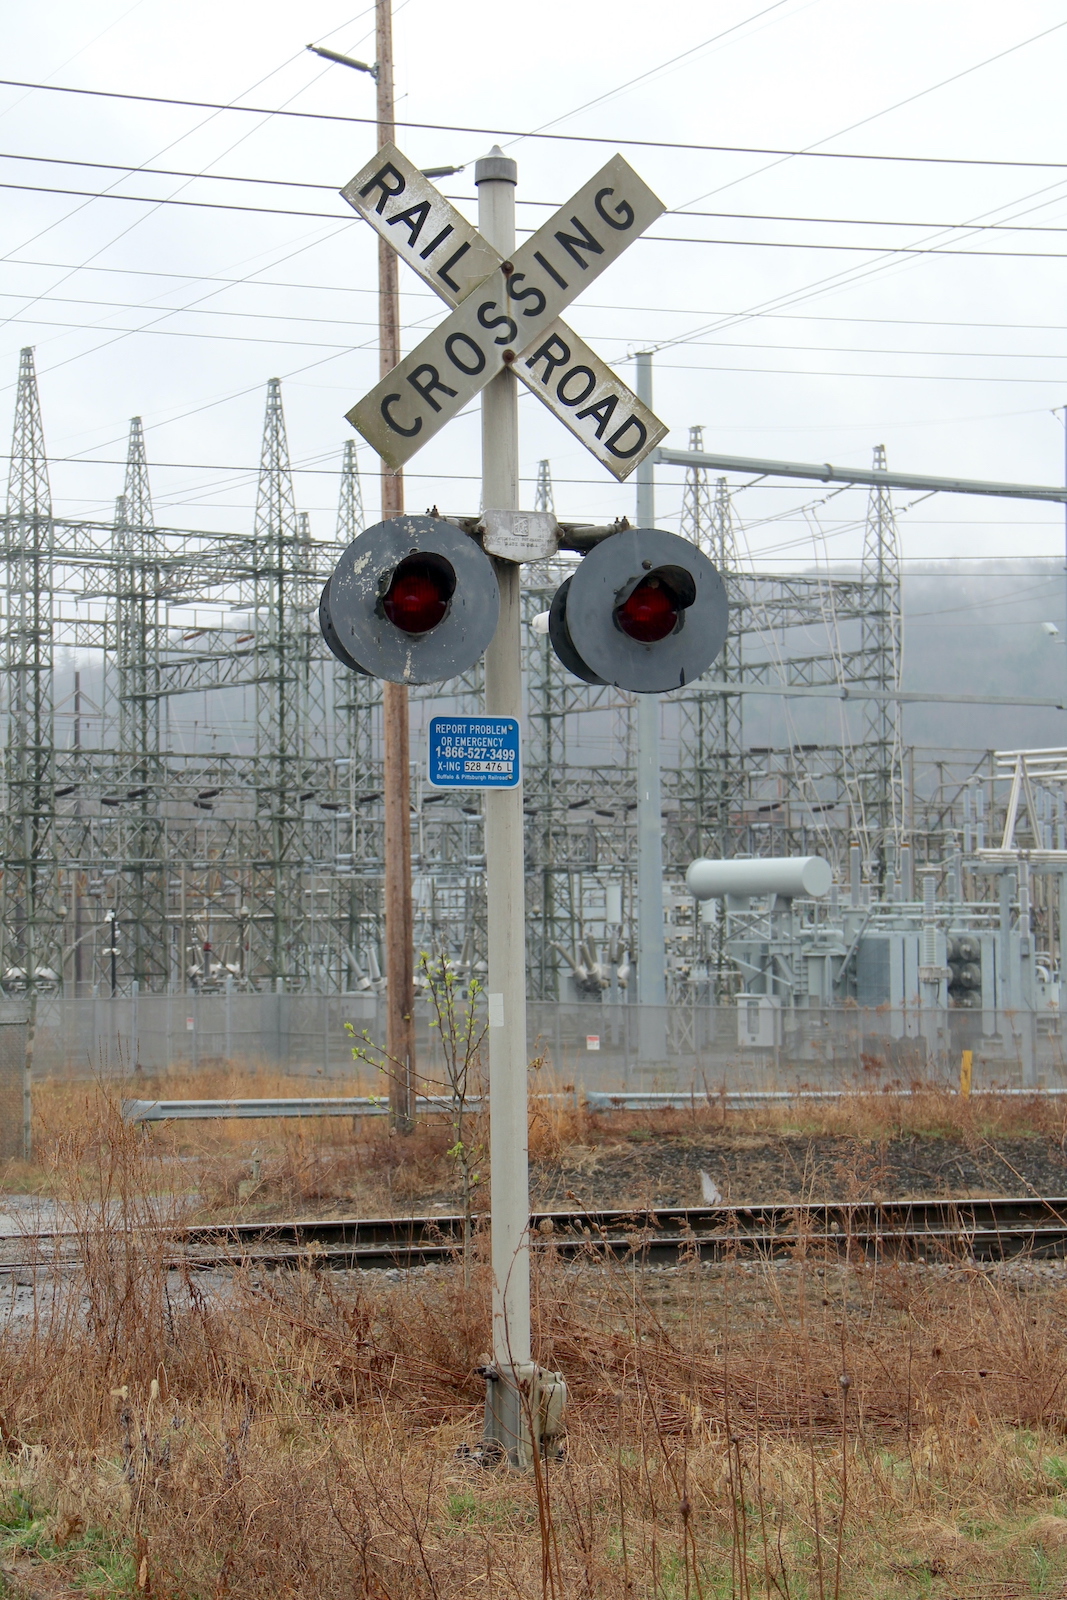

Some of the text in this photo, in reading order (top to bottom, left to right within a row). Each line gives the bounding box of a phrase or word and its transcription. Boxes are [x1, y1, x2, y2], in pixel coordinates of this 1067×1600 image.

[358, 161, 472, 293] RAIL
[380, 187, 635, 437] CROSSING
[524, 332, 648, 459] ROAD
[435, 723, 508, 735] REPORT PROBLEM
[440, 736, 504, 747] OR EMERGENCY
[435, 745, 516, 761] 1-866-527-3499
[437, 761, 512, 772] X-ING 528 476 L
